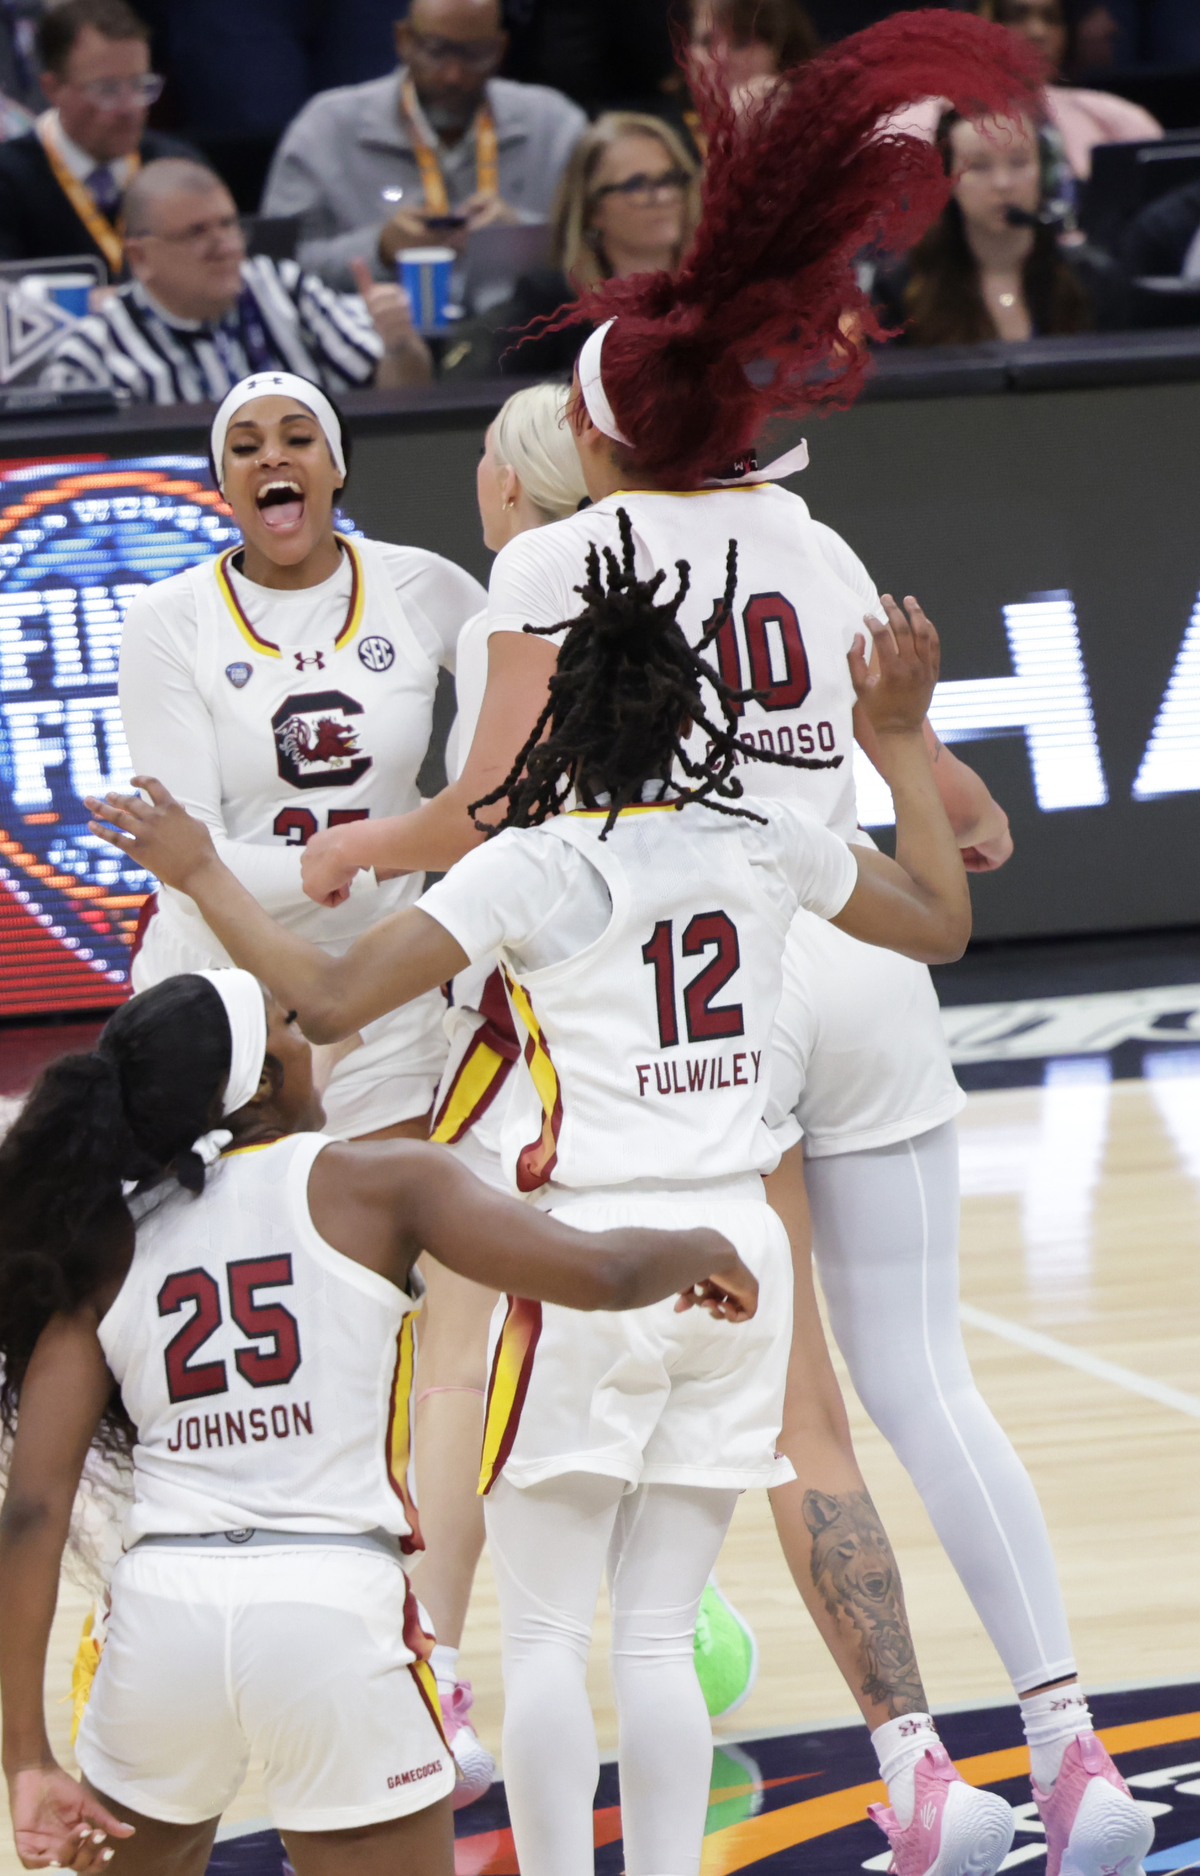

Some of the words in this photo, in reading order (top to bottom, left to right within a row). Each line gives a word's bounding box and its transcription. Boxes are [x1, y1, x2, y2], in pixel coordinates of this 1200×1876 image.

[360, 637, 393, 671] SEC
[702, 591, 812, 717] 10
[641, 910, 745, 1049] 12
[636, 1050, 761, 1096] FULWILEY
[157, 1253, 302, 1404] 25
[168, 1402, 313, 1452] JOHNSON
[387, 1759, 443, 1789] GAMECOCKS
